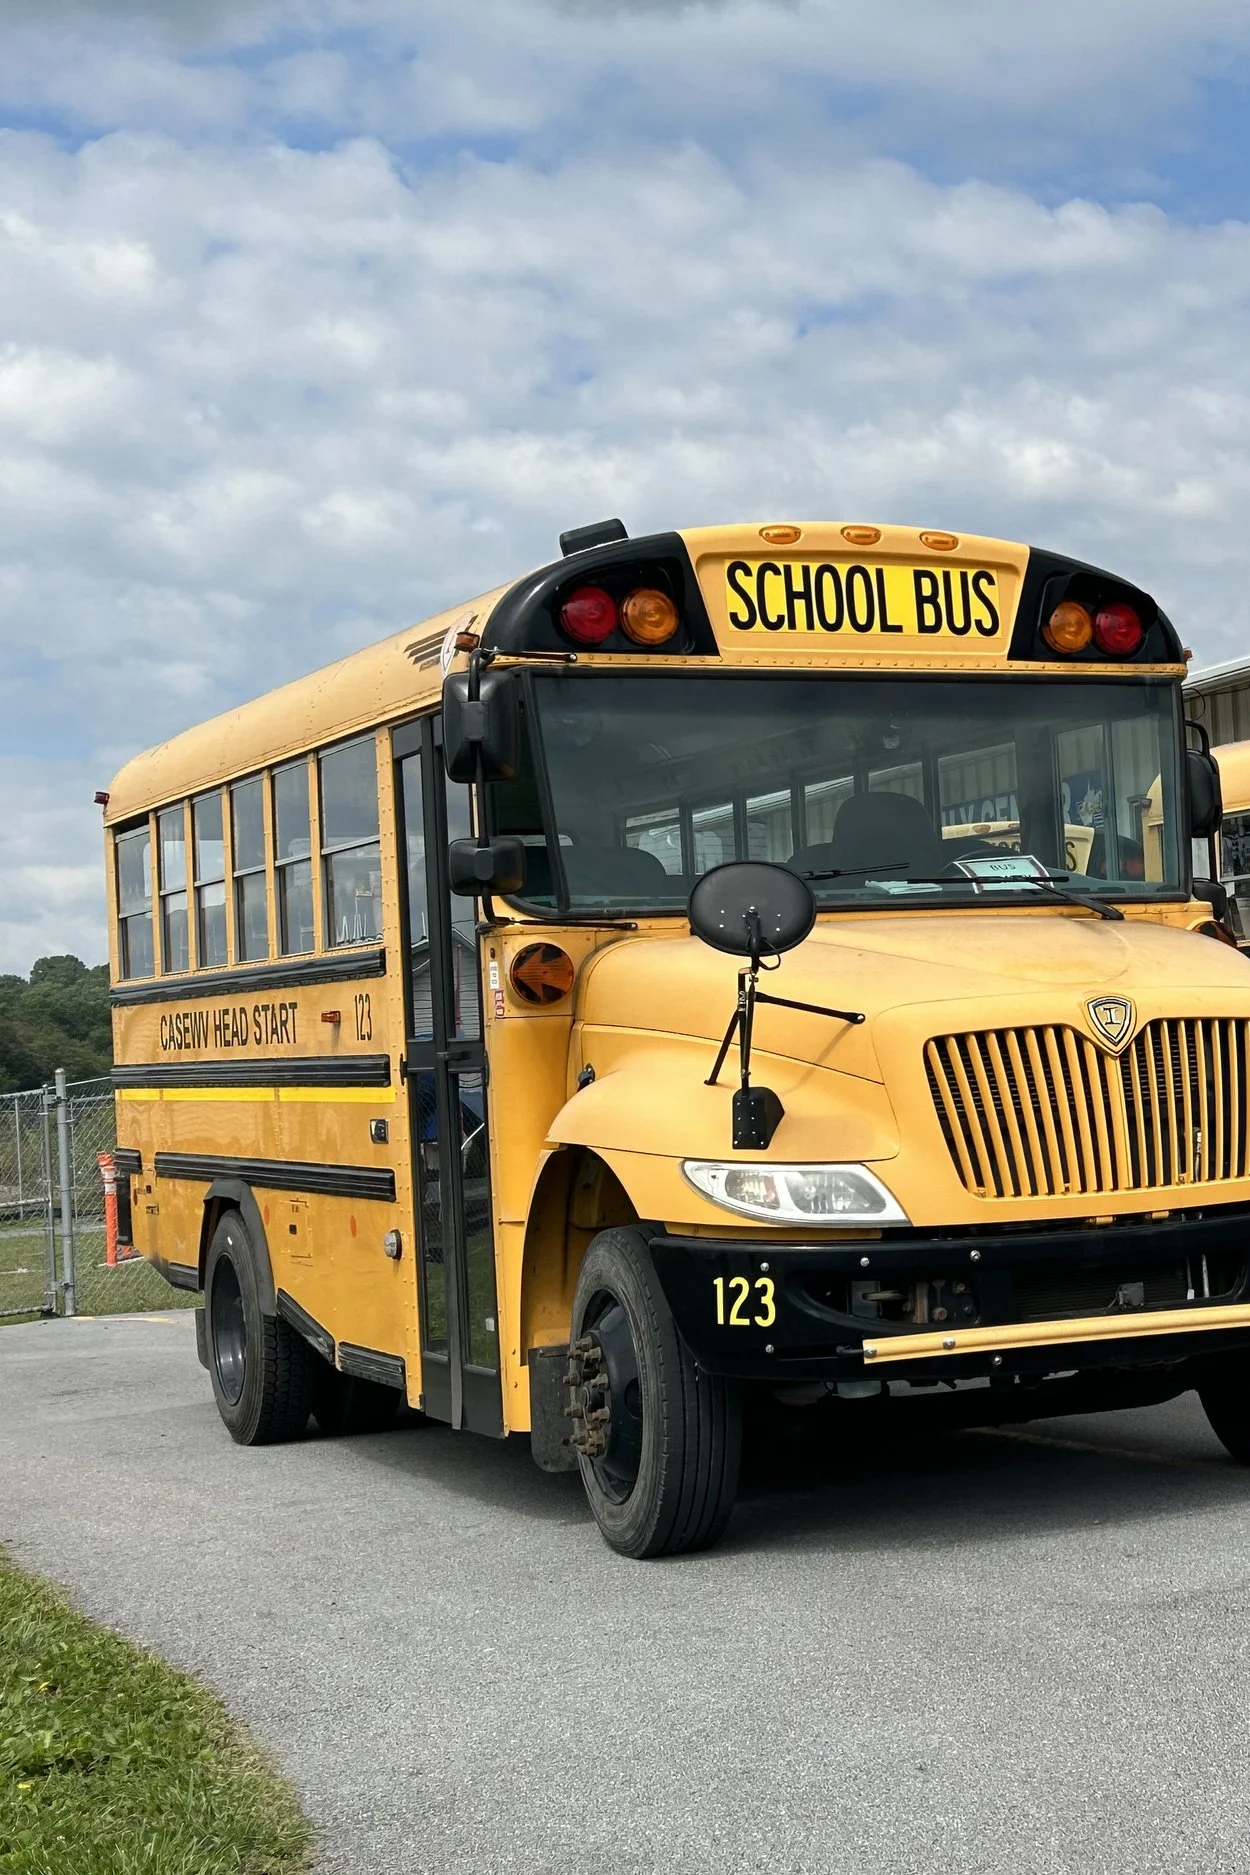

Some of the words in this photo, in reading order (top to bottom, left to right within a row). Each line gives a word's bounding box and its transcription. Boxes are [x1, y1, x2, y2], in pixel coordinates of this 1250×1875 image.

[726, 560, 904, 634] SCHOOL
[912, 568, 1000, 638] BUS
[160, 1010, 209, 1051] CASEWV
[213, 1006, 249, 1048] HEAD
[253, 1001, 298, 1046] START
[354, 993, 373, 1041] 123
[712, 1276, 776, 1327] 123
